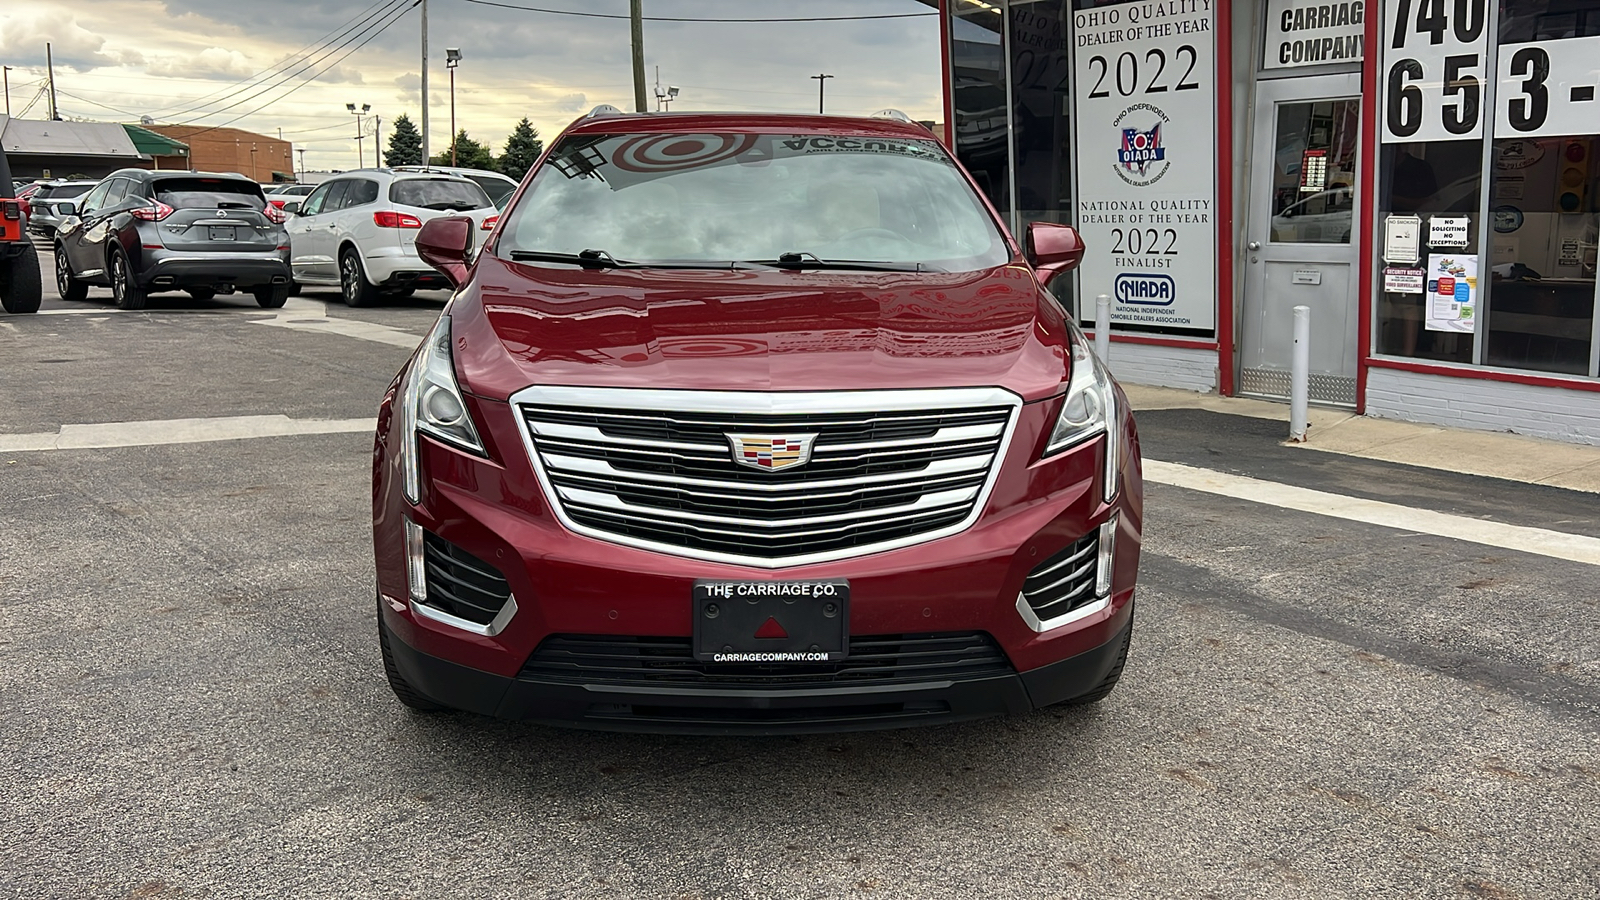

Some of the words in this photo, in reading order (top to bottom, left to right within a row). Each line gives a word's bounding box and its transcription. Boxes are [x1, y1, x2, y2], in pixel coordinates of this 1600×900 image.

[1075, 9, 1120, 29] OHIO
[1128, 0, 1210, 24] QUALITY
[1280, 1, 1364, 33] CARRIAG
[1078, 29, 1123, 47] DEALER
[1126, 27, 1143, 41] OF
[1146, 23, 1171, 39] THE
[1174, 18, 1209, 35] YEAR
[1088, 44, 1199, 99] 2022
[1112, 109, 1128, 127] OHIO
[1126, 102, 1170, 124] INDEPENDENT
[1123, 149, 1157, 162] OIADA
[1081, 201, 1145, 211] NATIONAL
[1150, 199, 1210, 212] QUALITY
[1082, 214, 1125, 224] DEALER
[1129, 214, 1144, 223] OF
[1149, 214, 1171, 223] THE
[1177, 213, 1208, 223] YEAR
[1110, 227, 1178, 255] 2022
[1115, 257, 1172, 268] FINALIST
[1119, 280, 1169, 301] NIADA
[1141, 307, 1176, 315] INDEPENDENT
[1155, 316, 1191, 324] ASSOCIATION
[705, 583, 734, 597] THE
[737, 583, 811, 596] CARRIAGE
[813, 583, 838, 597] CO.
[713, 652, 829, 662] CARRIAGECOMPANY.COM
